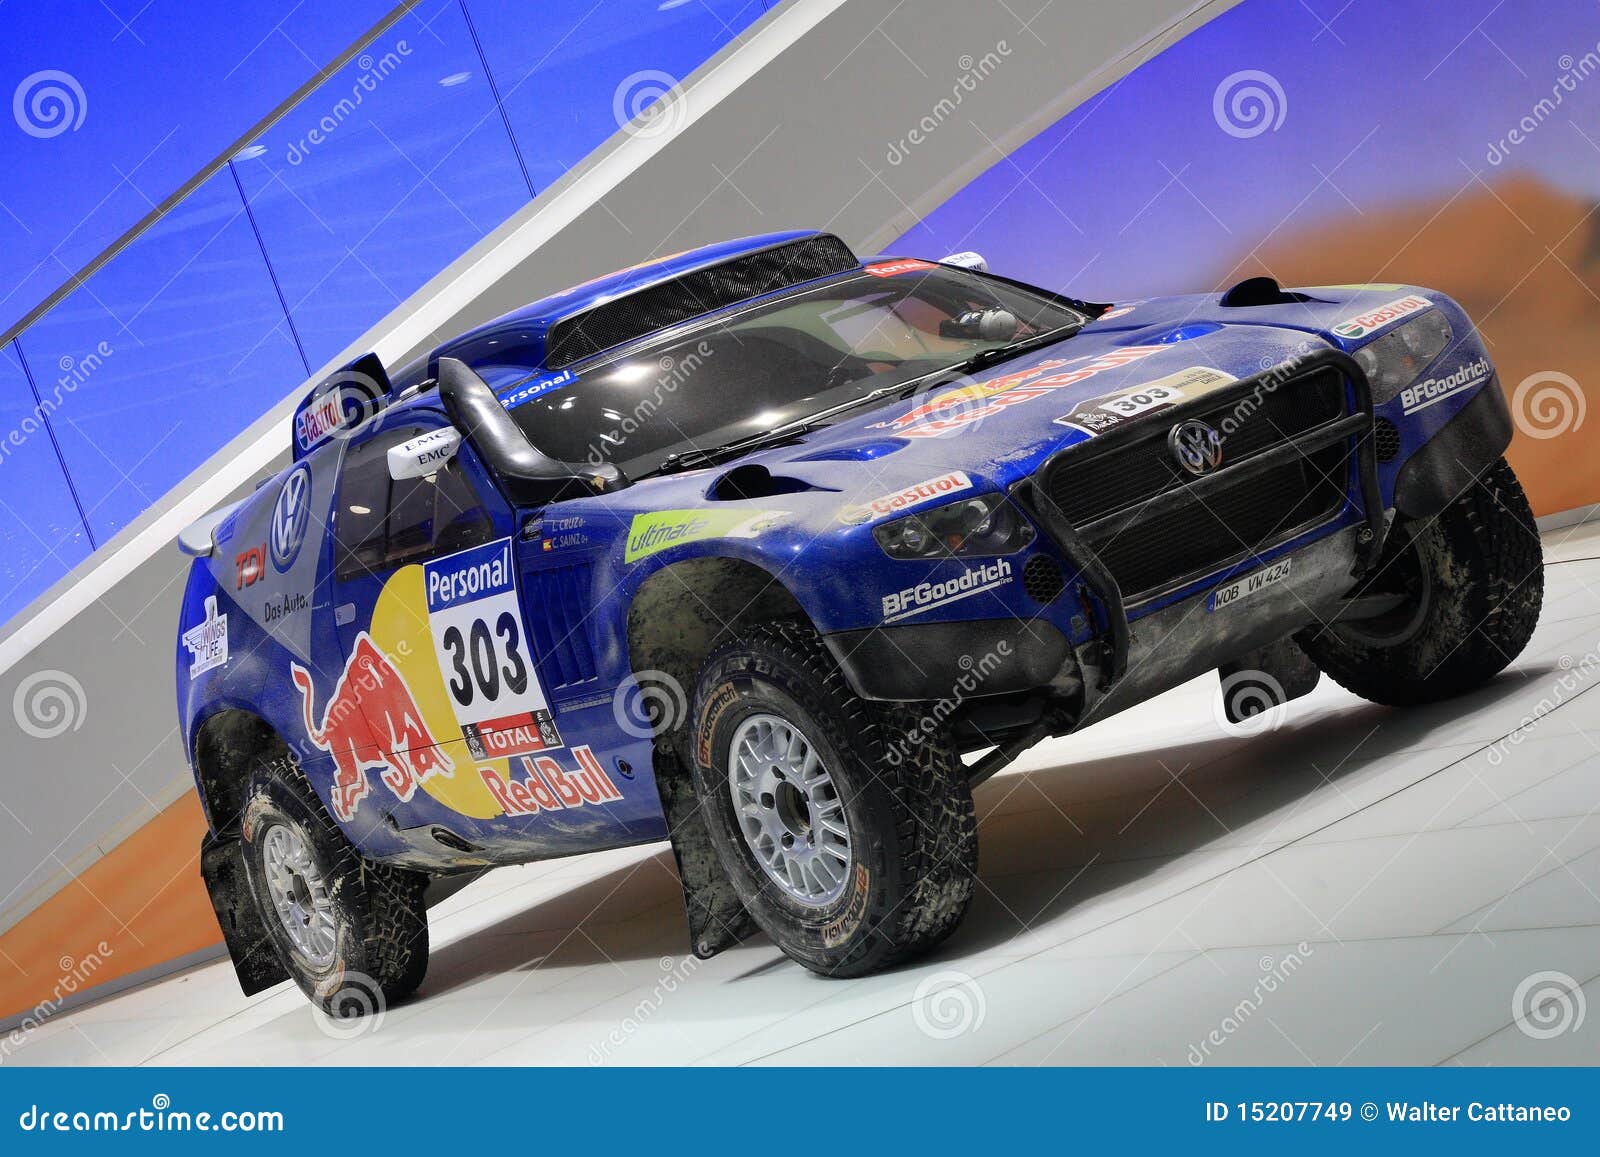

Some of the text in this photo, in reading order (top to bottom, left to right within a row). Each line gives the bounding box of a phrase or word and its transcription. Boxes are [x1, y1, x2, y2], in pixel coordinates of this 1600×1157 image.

[1356, 297, 1428, 329] Castrol
[500, 370, 571, 408] ersonal
[1113, 388, 1170, 412] 303
[1400, 357, 1490, 409] BFGoodrich
[305, 393, 342, 441] Castrol
[418, 444, 449, 465] EMC
[872, 475, 965, 513] Castrol
[236, 544, 267, 591] TDI
[429, 547, 509, 606] Personal
[882, 558, 1013, 617] BFGoodrich
[1215, 561, 1289, 607] WOB VW 424
[265, 602, 282, 623] Das
[443, 611, 528, 707] 303
[481, 725, 540, 750] TOTAL
